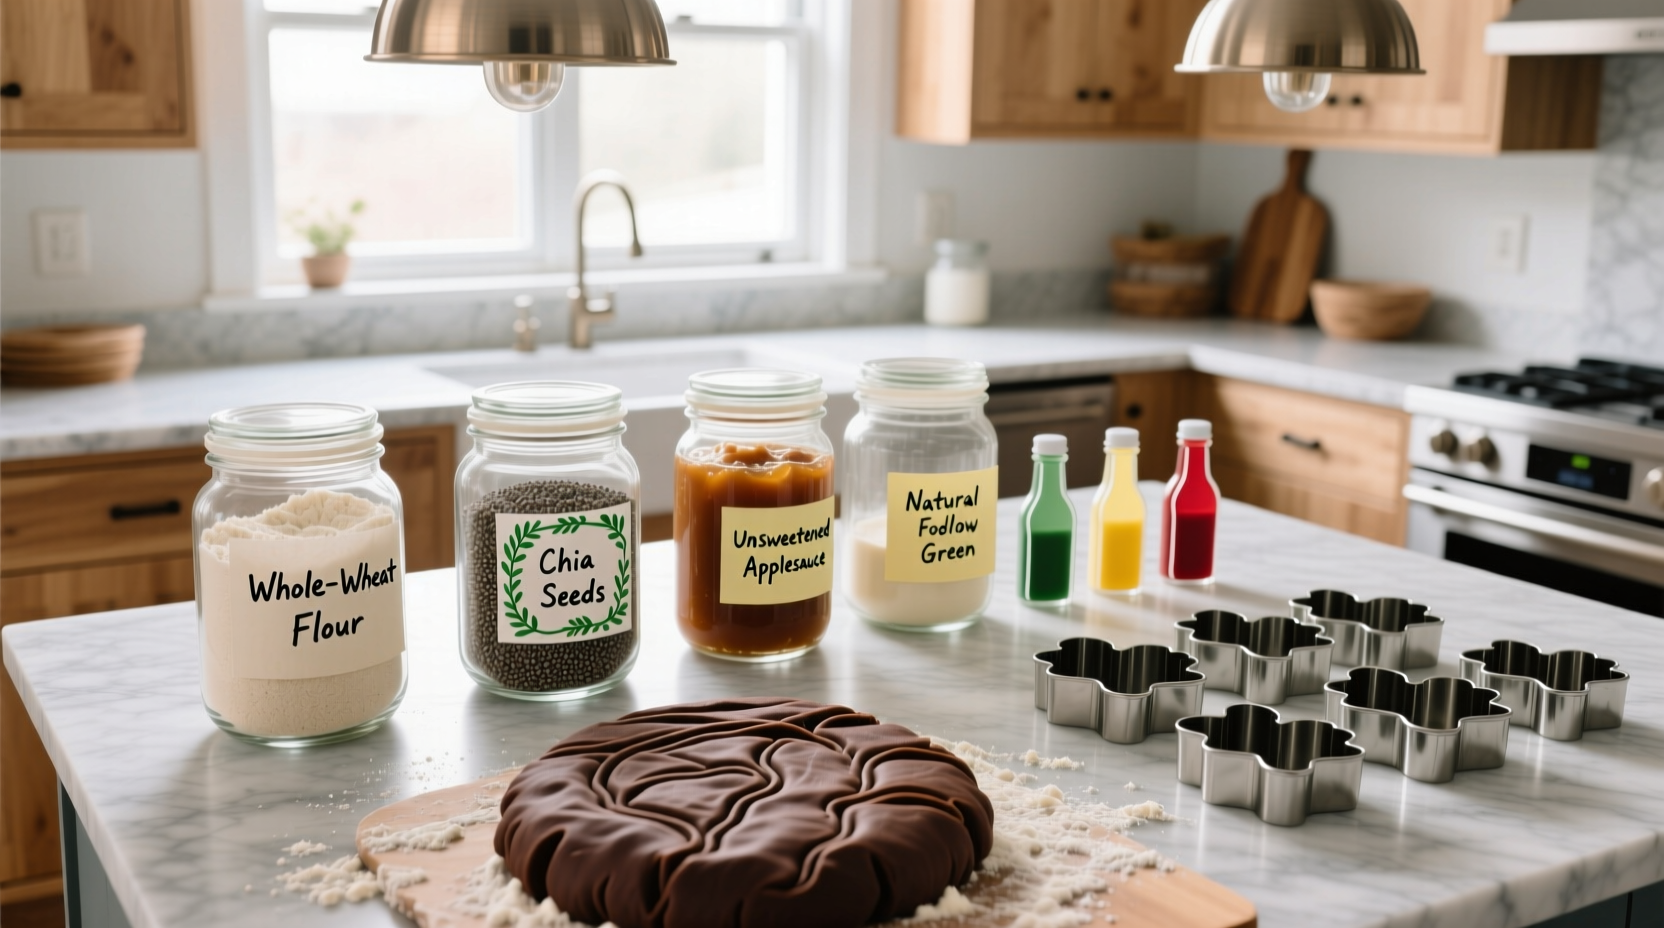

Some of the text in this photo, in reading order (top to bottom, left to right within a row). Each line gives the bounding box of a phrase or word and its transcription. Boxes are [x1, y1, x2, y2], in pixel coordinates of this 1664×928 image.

[905, 485, 979, 511] Natural
[733, 518, 831, 548] Unsweetened
[918, 514, 978, 537] Fodlow
[540, 547, 595, 575] Chia
[743, 551, 826, 584] Applesauce
[921, 543, 975, 563] Green
[248, 558, 397, 602] Whole-Wheat
[540, 578, 606, 608] Seeds
[292, 610, 365, 647] Flour
